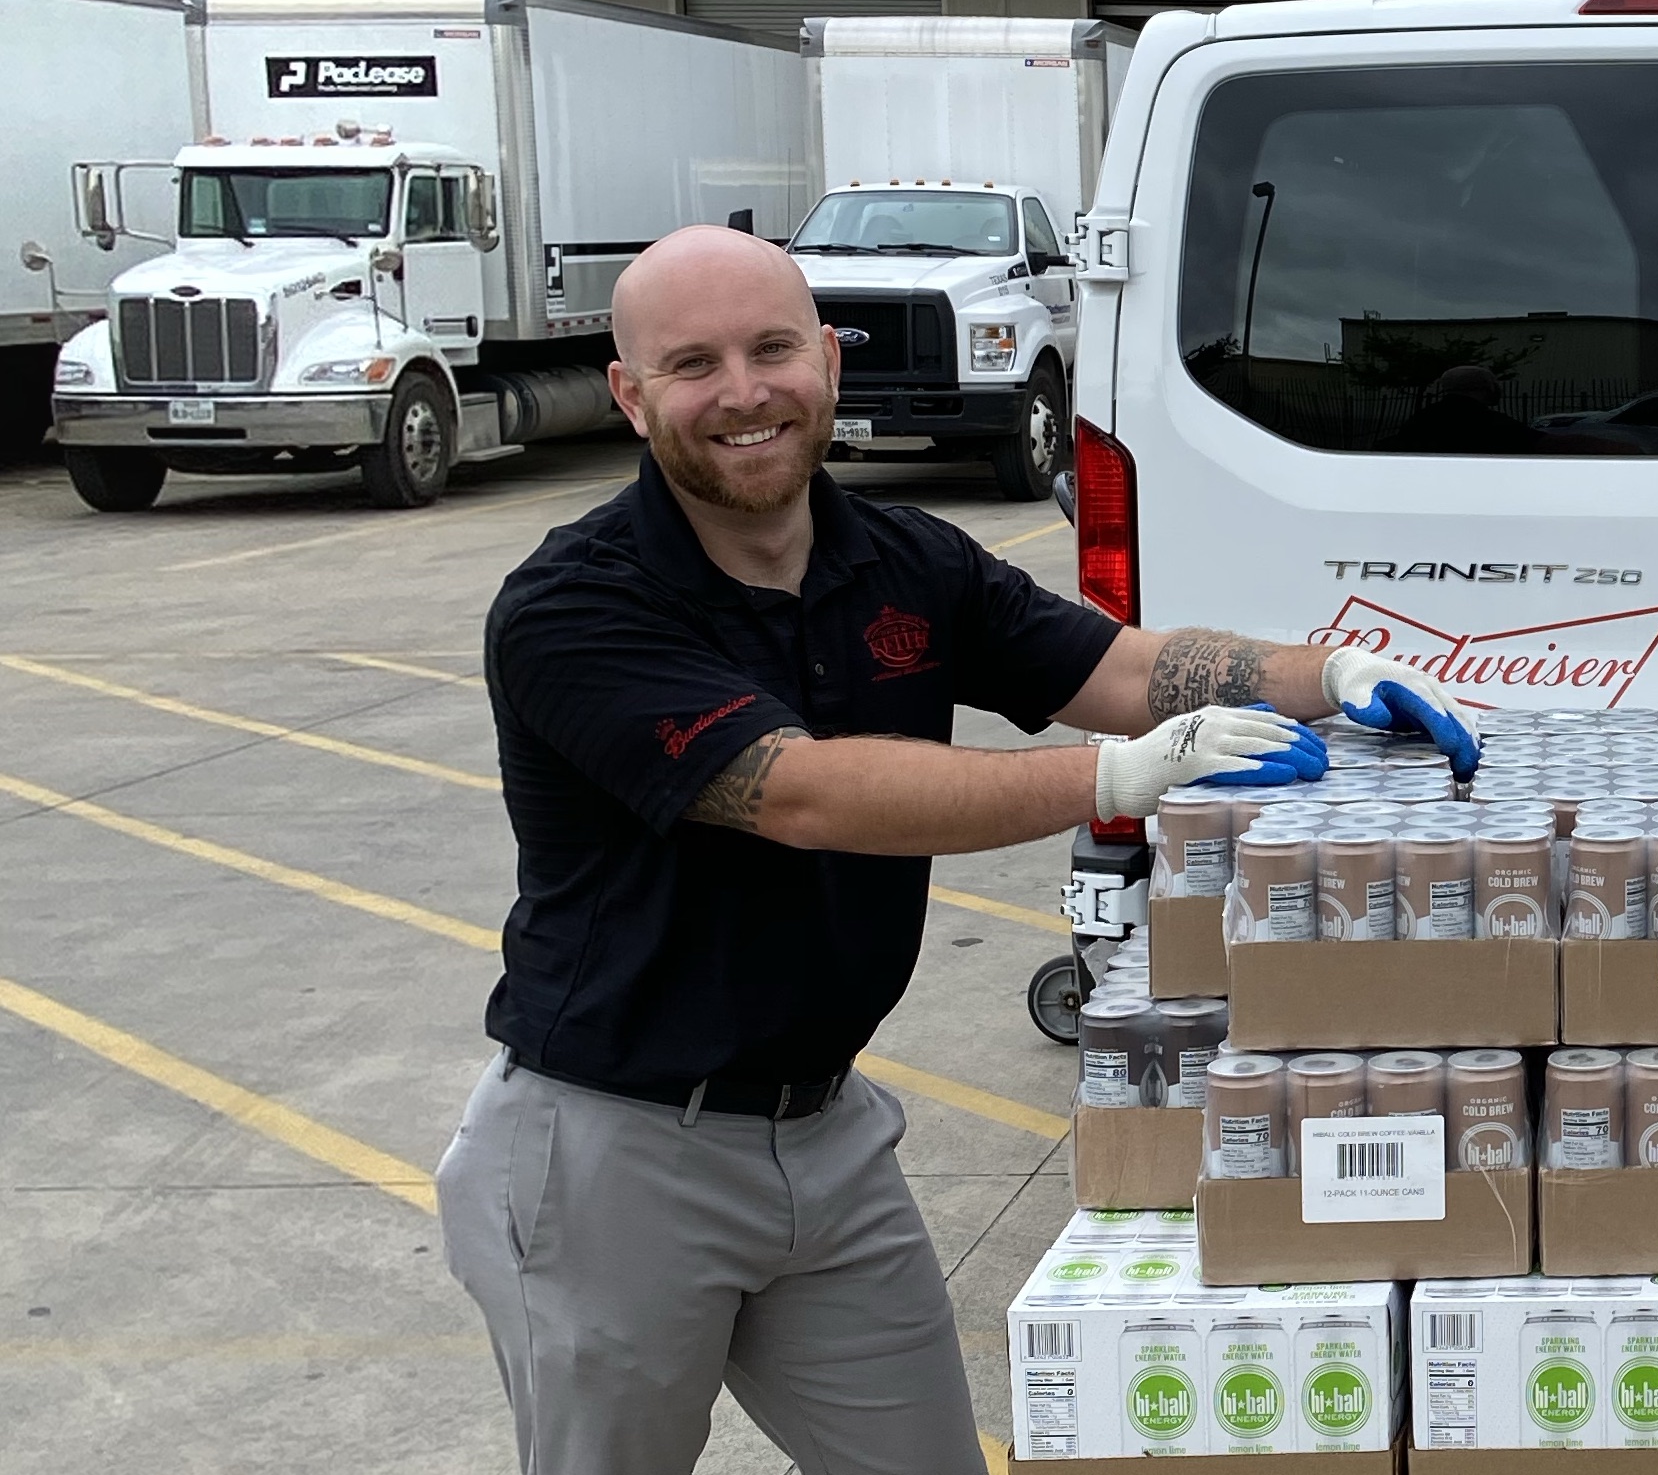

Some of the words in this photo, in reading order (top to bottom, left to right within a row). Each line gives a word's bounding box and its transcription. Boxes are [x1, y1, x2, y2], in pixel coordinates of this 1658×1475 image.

[317, 61, 425, 84] PacLease
[1324, 560, 1569, 584] TRANSIT
[1573, 567, 1643, 586] 250
[1488, 877, 1511, 888] COLD
[1513, 876, 1538, 887] BREW
[1463, 1106, 1487, 1116] COLD
[1489, 1103, 1514, 1116] BREW
[1596, 1125, 1609, 1134] 70
[1256, 1132, 1269, 1141] 70
[1323, 1189, 1357, 1198] 12-PACK
[1402, 1187, 1425, 1196] CANS
[1318, 1413, 1358, 1422] ENERGY
[1541, 1408, 1581, 1416] ENERGY
[1315, 1443, 1341, 1452] lemon
[1344, 1441, 1361, 1451] lime
[1539, 1438, 1564, 1447] lemon
[1566, 1438, 1583, 1447] lime
